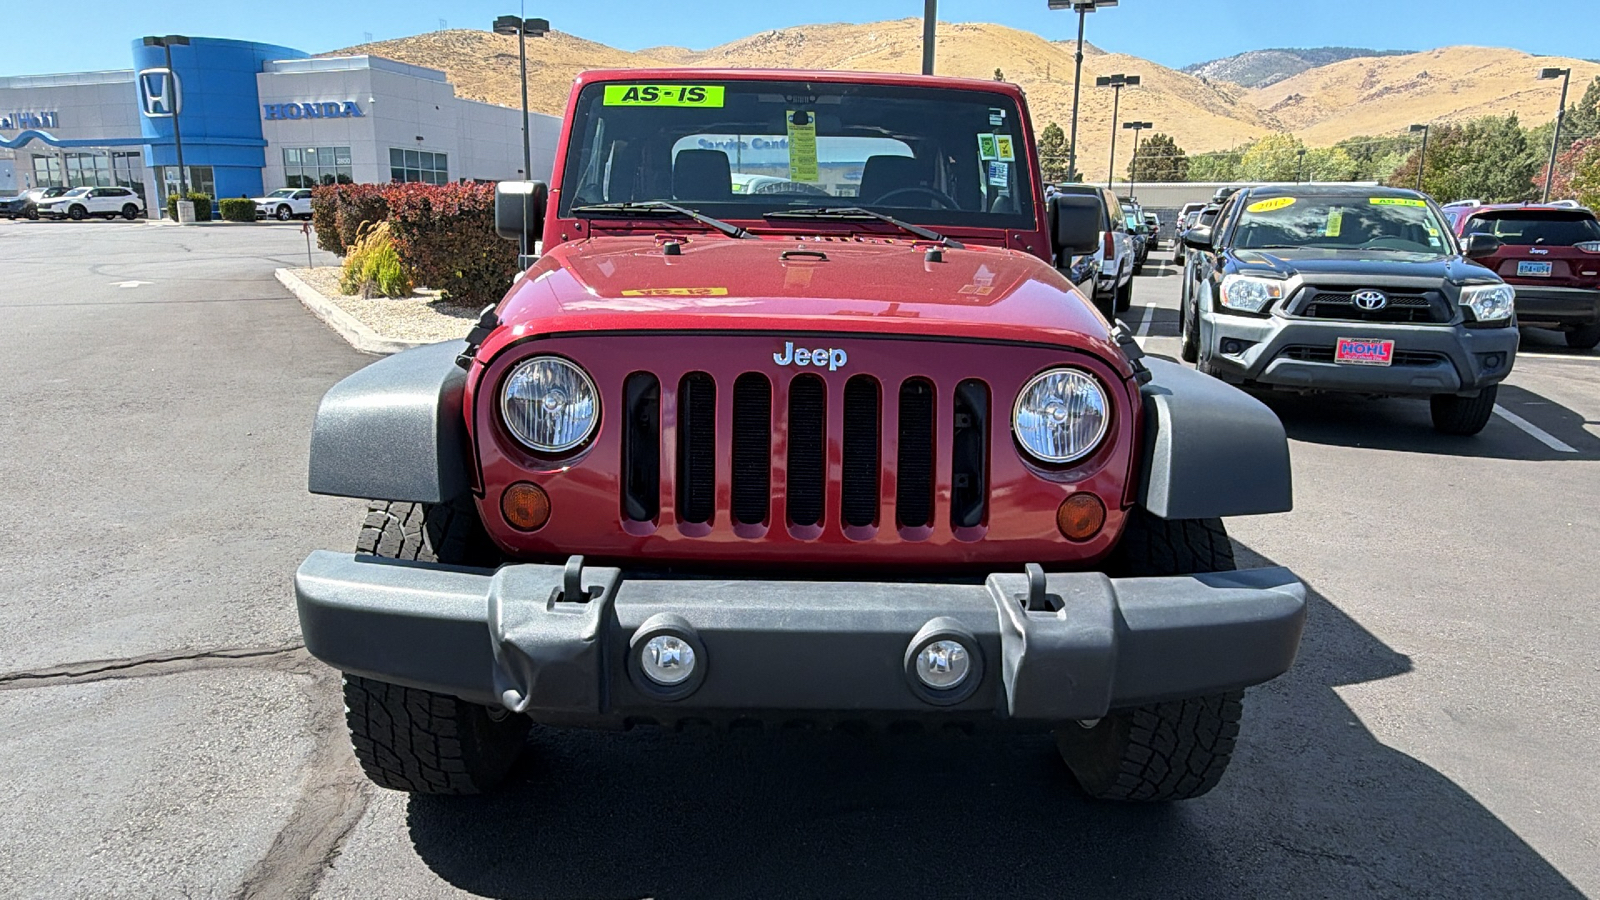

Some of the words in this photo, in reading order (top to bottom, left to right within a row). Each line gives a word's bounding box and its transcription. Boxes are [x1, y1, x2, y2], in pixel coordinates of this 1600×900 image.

[263, 101, 365, 120] HONDA
[698, 138, 748, 150] Service
[1259, 198, 1286, 210] 2012
[1529, 247, 1548, 255] Jeep
[773, 341, 847, 371] Jeep
[1342, 344, 1386, 356] HOHL
